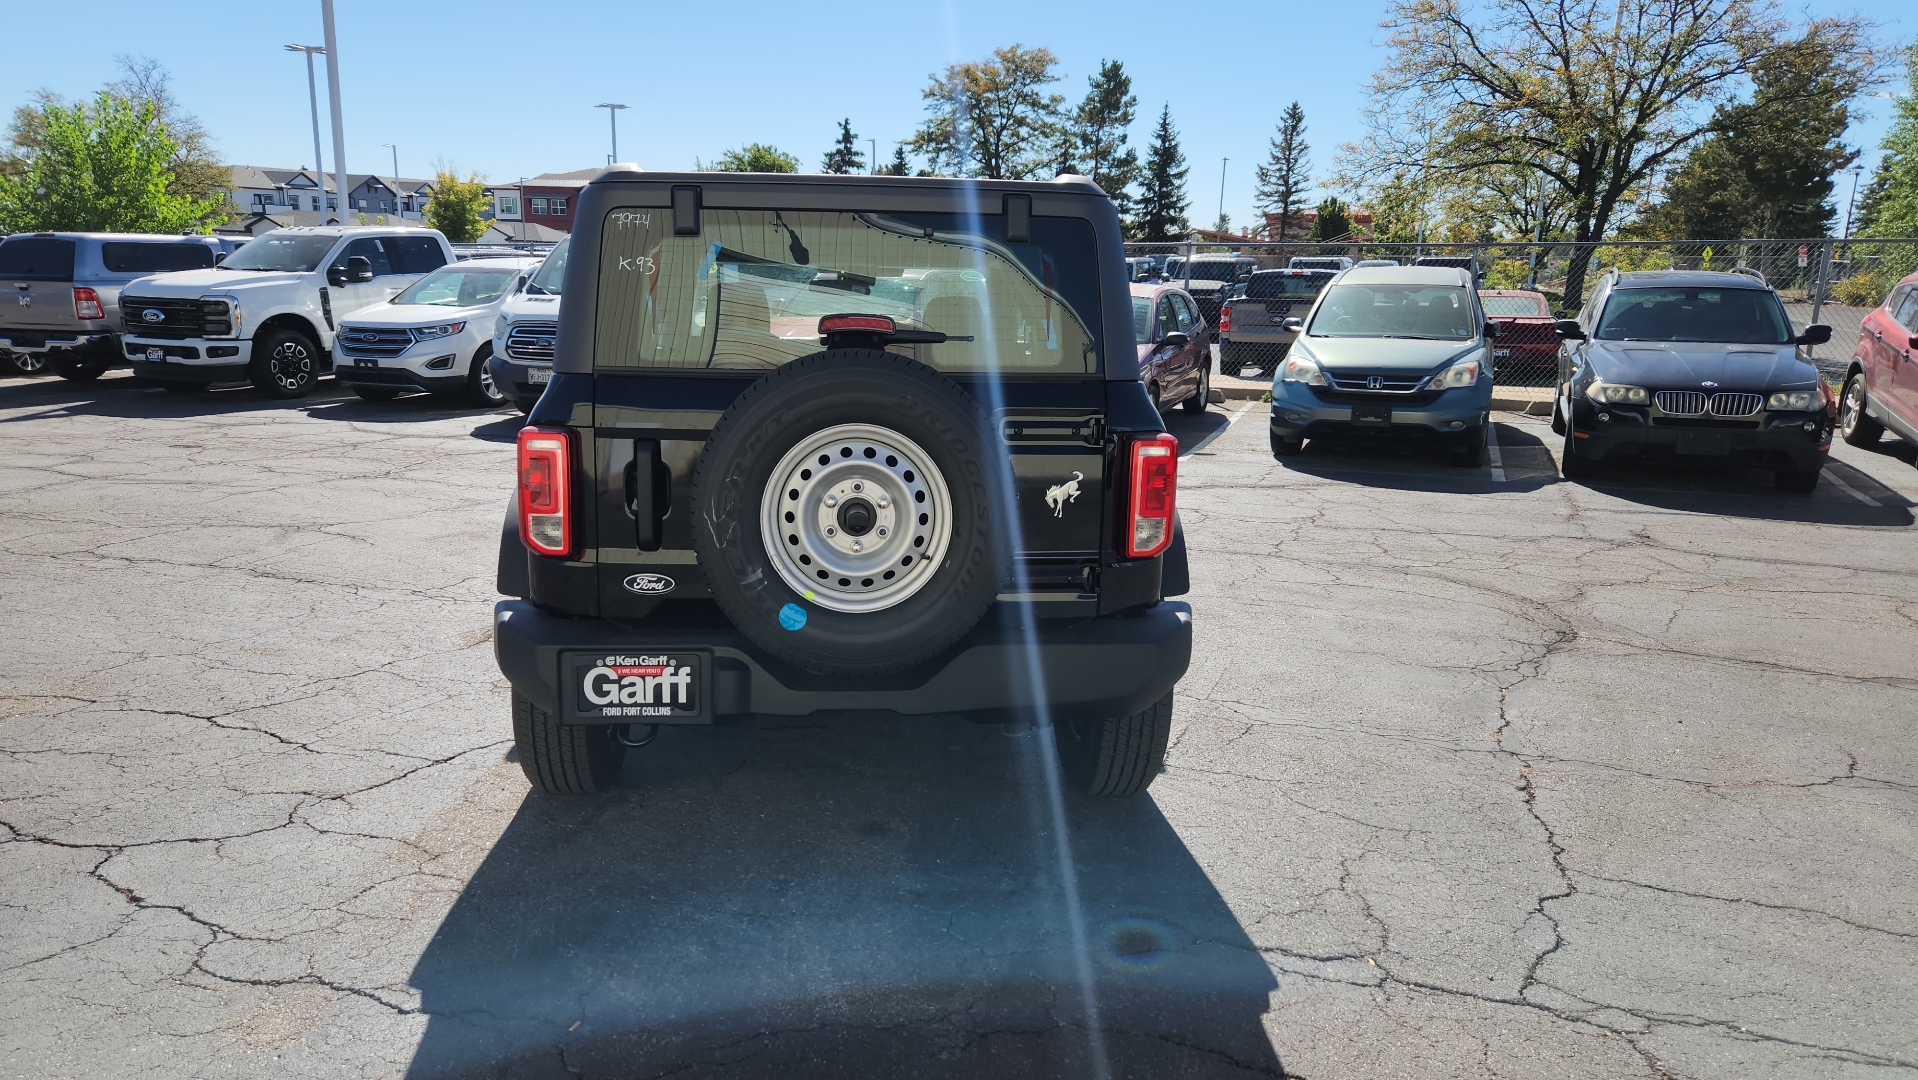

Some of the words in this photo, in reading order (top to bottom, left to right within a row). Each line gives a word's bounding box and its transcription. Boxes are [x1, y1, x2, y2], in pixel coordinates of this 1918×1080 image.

[611, 212, 651, 231] 7974
[146, 349, 164, 360] Garff
[632, 575, 667, 591] Ford
[616, 655, 639, 666] Ken
[639, 655, 668, 666] Garff
[583, 666, 691, 705] Garff
[602, 707, 621, 716] FORD
[622, 707, 641, 716] FORT
[642, 706, 671, 716] COLLINS
